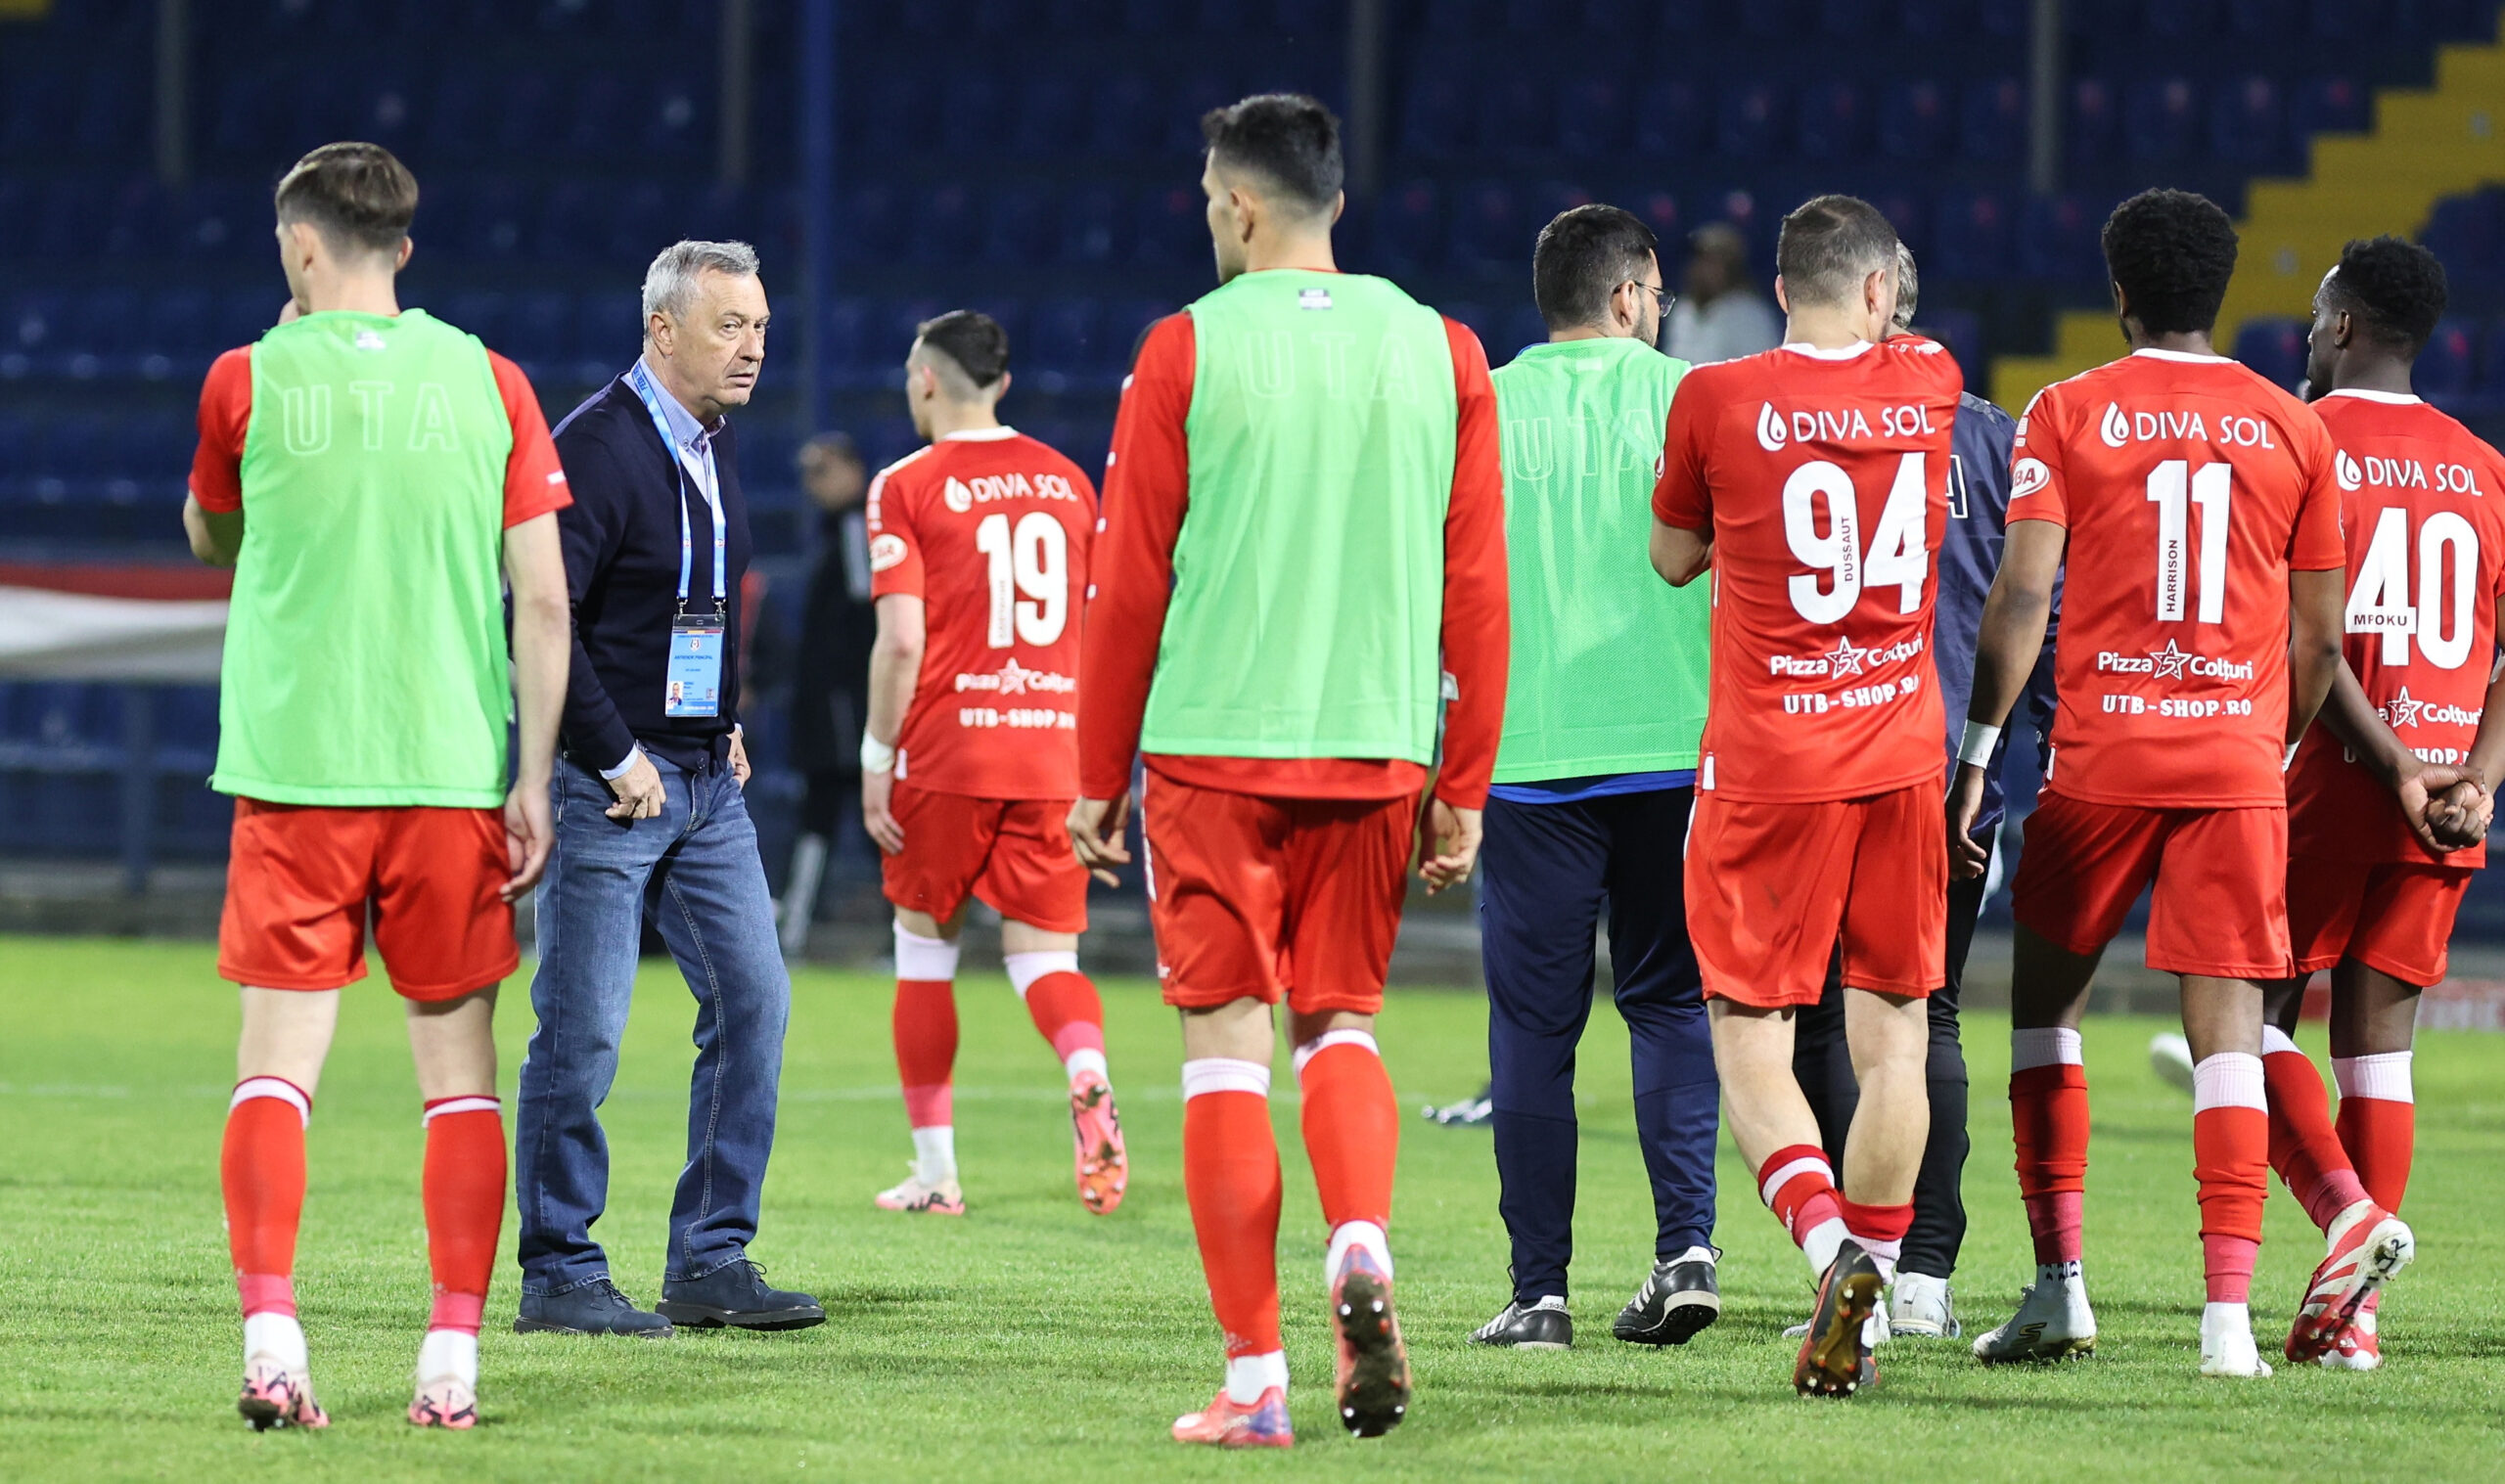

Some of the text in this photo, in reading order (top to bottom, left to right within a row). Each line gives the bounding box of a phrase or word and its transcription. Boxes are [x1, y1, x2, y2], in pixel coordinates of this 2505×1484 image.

[283, 381, 461, 456] UTA
[1793, 404, 1936, 442] DIVA SOL
[2135, 411, 2275, 450] DIVA SOL
[970, 472, 1078, 503] DIVA SOL
[2364, 456, 2483, 497] DIVA SOL
[1782, 451, 1930, 625] 94
[1842, 516, 1852, 583] DUSSAUT
[2146, 460, 2232, 624] 11
[976, 512, 1069, 649] 19
[2166, 539, 2178, 612] HARRISON
[2345, 507, 2480, 670] 40
[1770, 654, 1830, 676] Pizza
[2098, 652, 2153, 673] Pizza
[2103, 695, 2253, 718] UTB-SHOP.RO
